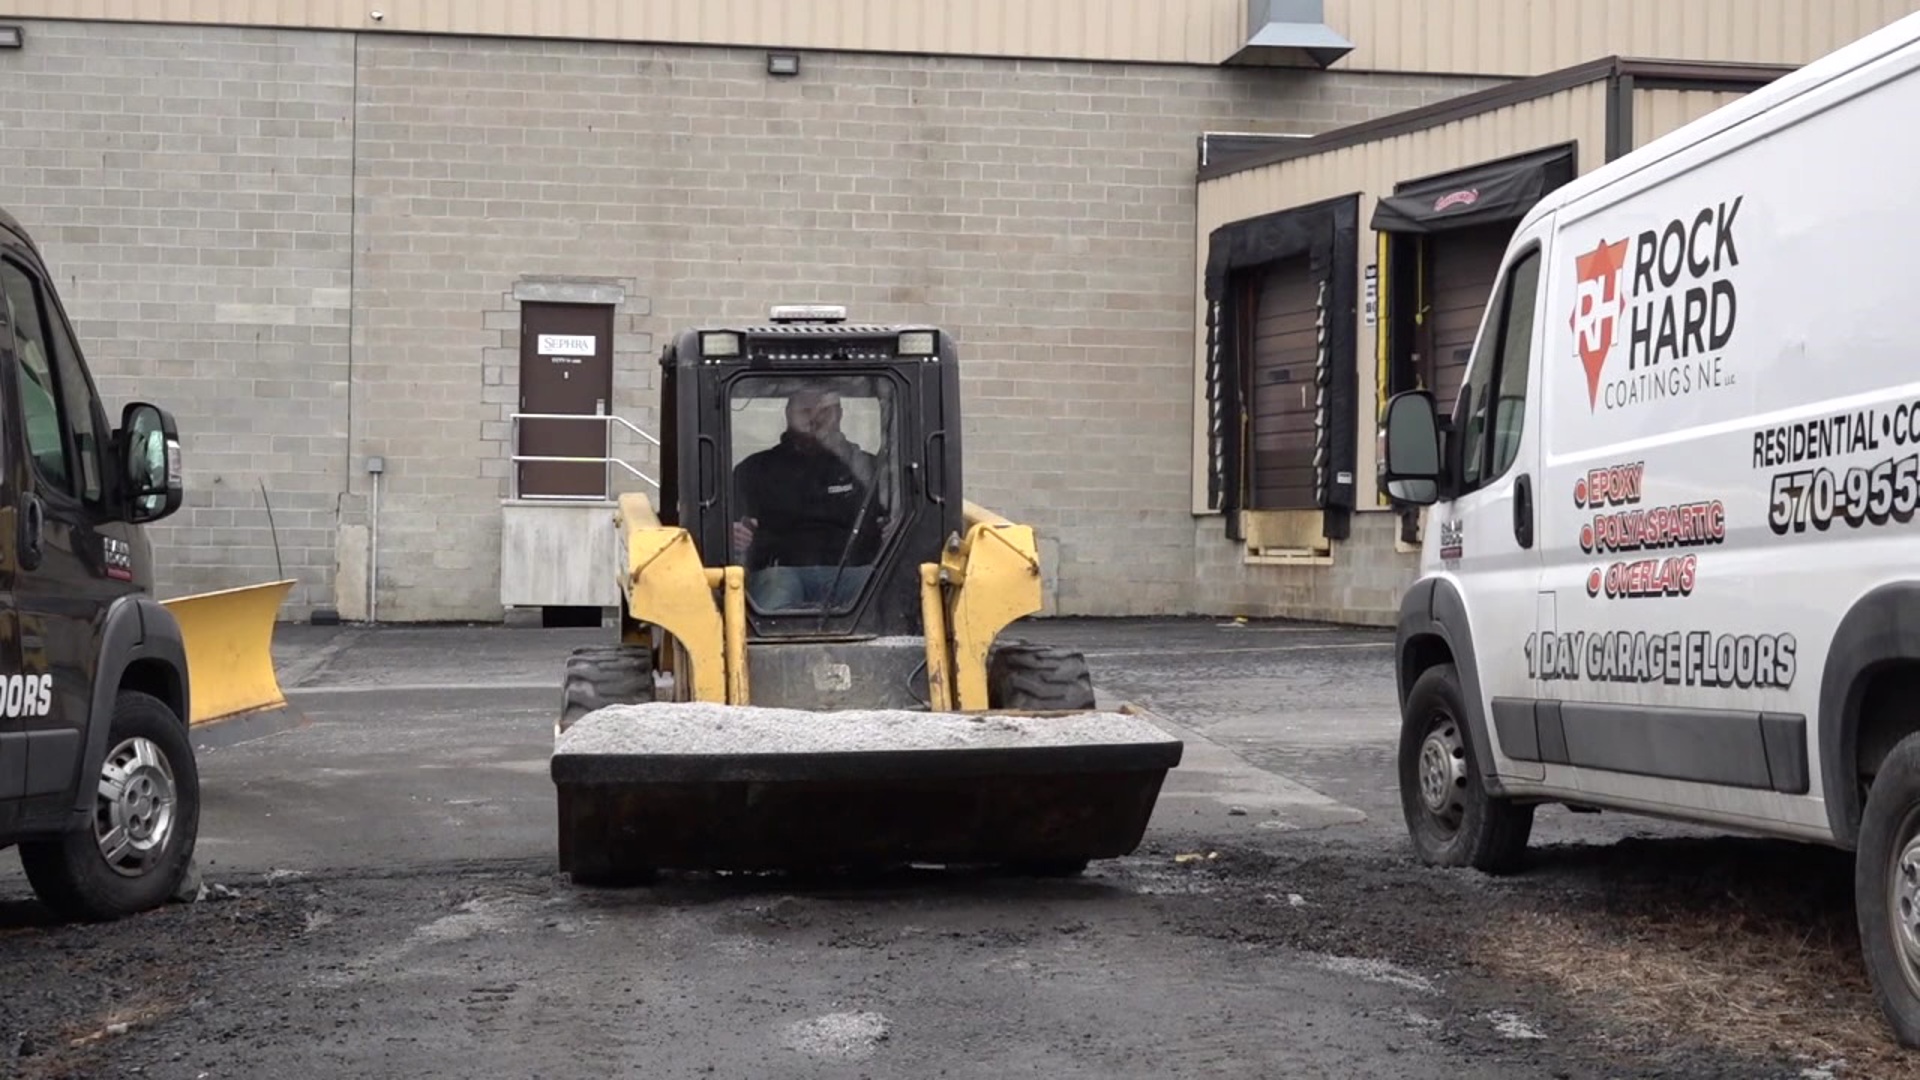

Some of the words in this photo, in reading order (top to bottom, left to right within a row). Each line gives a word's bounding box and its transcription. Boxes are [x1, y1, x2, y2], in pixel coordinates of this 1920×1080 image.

[1633, 195, 1743, 297] ROCK
[1629, 278, 1737, 371] HARD
[1604, 364, 1691, 410] COATINGS
[1698, 356, 1722, 391] NE
[1753, 410, 1879, 469] RESIDENTIAL
[1588, 461, 1644, 509] EPOXY
[1768, 453, 1920, 535] 570-955
[1594, 499, 1725, 554] POLYASPARTIC
[1605, 553, 1697, 600] OVERLAYS
[1524, 631, 1537, 679] 1
[1540, 630, 1585, 681] DAY
[1586, 630, 1682, 685] GARAGE
[1686, 630, 1797, 691] FLOORS
